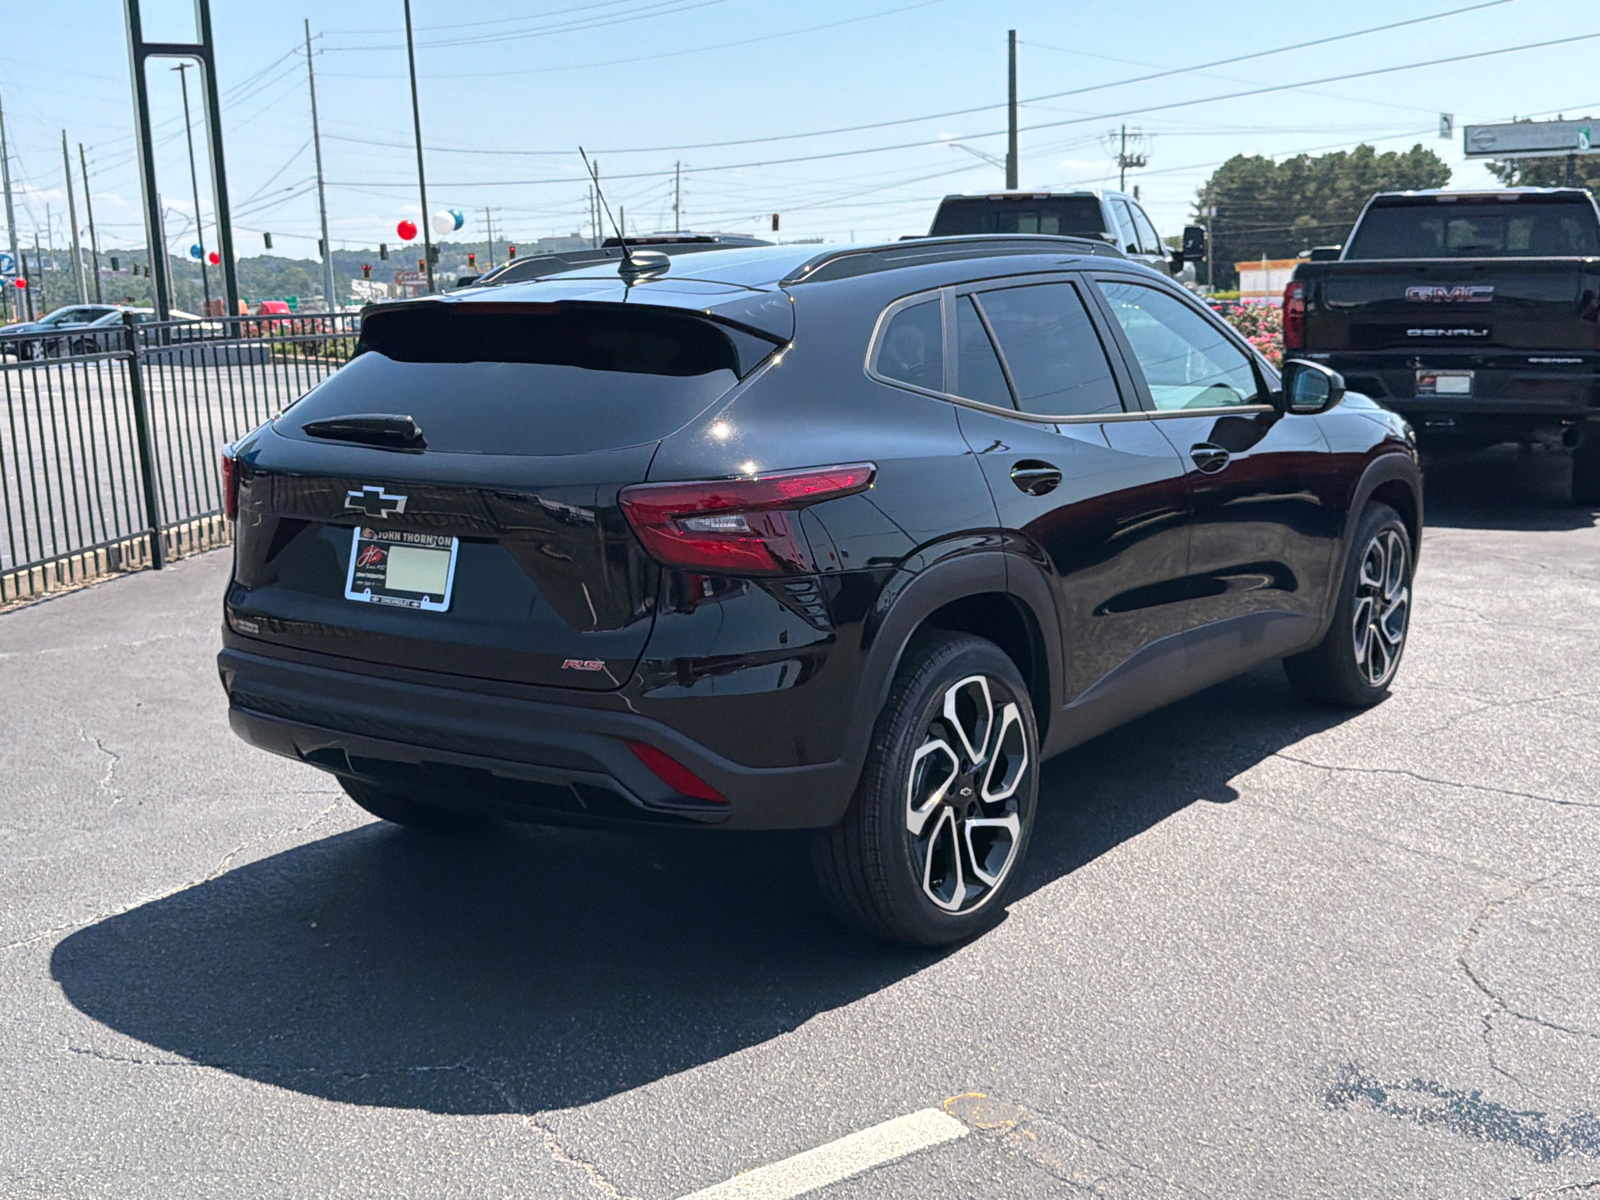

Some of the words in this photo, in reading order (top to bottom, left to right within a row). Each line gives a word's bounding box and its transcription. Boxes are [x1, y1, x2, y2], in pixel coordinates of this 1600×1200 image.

[1405, 286, 1495, 302] GMC
[1406, 328, 1489, 336] DENALI
[378, 530, 401, 541] JOHN
[402, 532, 452, 546] THORNTON
[561, 658, 605, 671] RS
